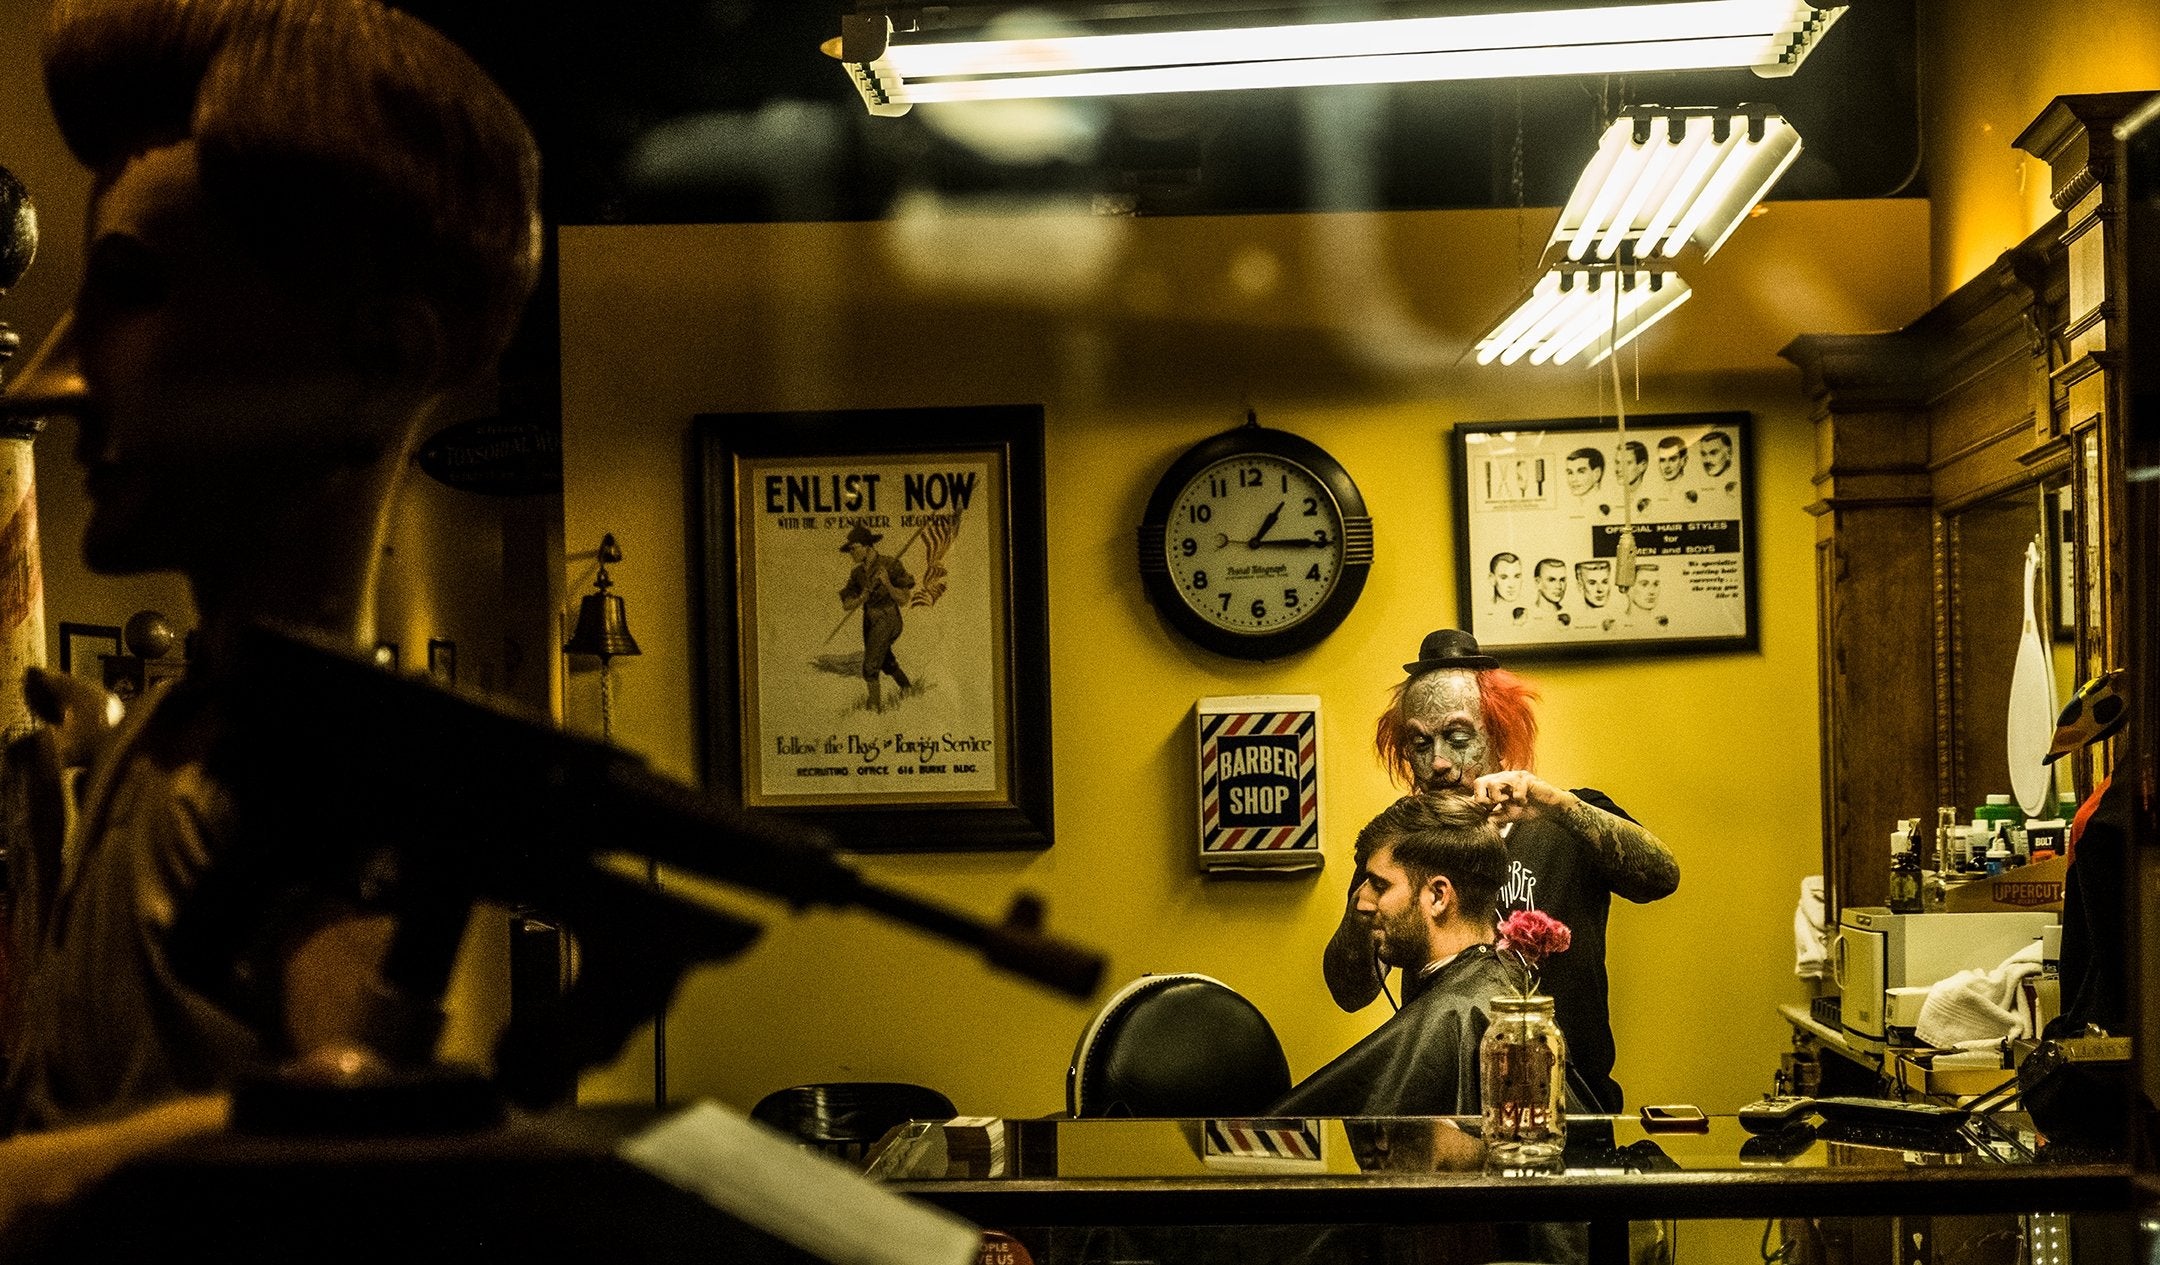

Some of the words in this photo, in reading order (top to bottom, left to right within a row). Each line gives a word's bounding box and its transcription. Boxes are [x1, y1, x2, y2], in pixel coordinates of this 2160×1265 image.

[1240, 468, 1263, 488] 12
[1281, 474, 1288, 494] 1
[765, 474, 881, 513] ENLIST
[904, 472, 976, 512] NOW
[1211, 478, 1227, 498] 11
[1190, 504, 1211, 523] 10
[1303, 498, 1318, 517] 2
[1656, 523, 1683, 532] HAIR
[1687, 521, 1728, 531] STYLES
[1182, 538, 1198, 557] 9
[1314, 530, 1328, 549] 3
[1663, 535, 1679, 543] for
[1661, 546, 1681, 554] and
[1685, 545, 1716, 554] BOYS
[1193, 570, 1208, 590] 8
[1306, 563, 1321, 581] 4
[1218, 593, 1232, 612] 7
[1284, 589, 1299, 608] 5
[1251, 600, 1266, 618] 6
[777, 736, 819, 755] Follow
[942, 732, 992, 752] Service
[796, 766, 849, 777] RECRUITING
[856, 765, 889, 776] OFFICE
[897, 764, 914, 775] 616
[1220, 746, 1299, 781] BARBER
[1229, 785, 1291, 815] SHOP
[2034, 836, 2054, 847] BOLT
[1994, 884, 2061, 901] UPPERCUT
